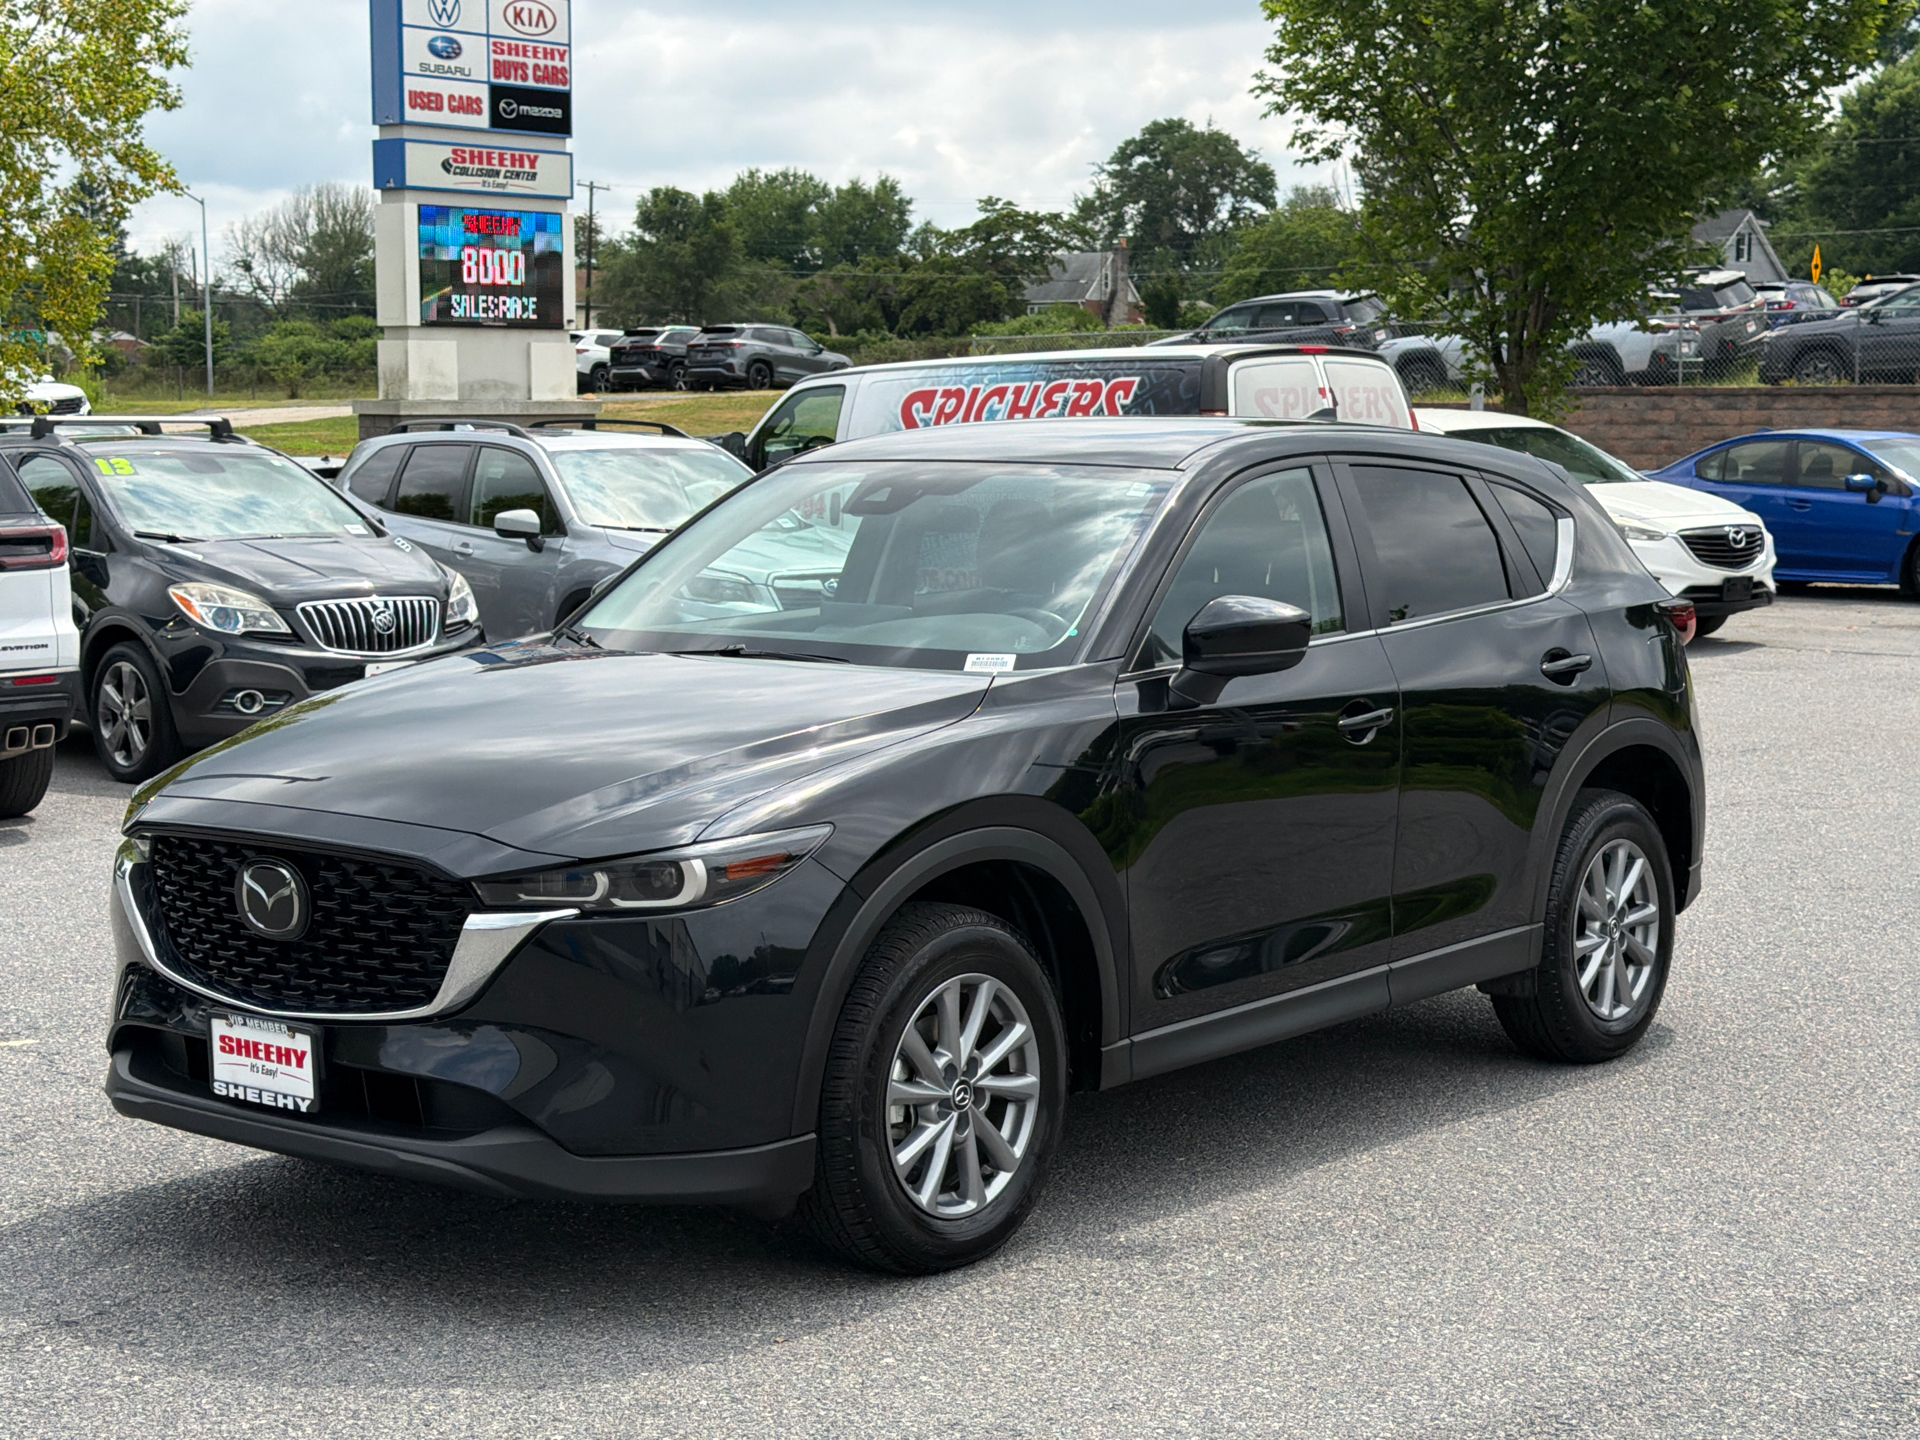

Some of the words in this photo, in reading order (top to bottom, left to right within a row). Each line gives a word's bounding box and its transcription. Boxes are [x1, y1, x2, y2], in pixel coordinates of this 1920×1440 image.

[513, 5, 548, 29] KIA
[491, 40, 567, 62] SHEEHY
[419, 62, 471, 77] SUBARU
[493, 59, 528, 82] BUYS
[532, 63, 568, 86] CARS
[408, 90, 443, 111] USED
[447, 94, 483, 116] CARS
[451, 148, 539, 169] SHEEHY
[452, 165, 501, 179] COLLISION
[503, 169, 537, 181] CENTER
[901, 378, 1140, 430] SPICHERS
[94, 457, 135, 476] 13
[228, 1014, 244, 1027] VIP
[246, 1017, 288, 1034] MEMBER
[218, 1034, 308, 1069] SHEEHY
[249, 1062, 260, 1073] It's
[261, 1065, 279, 1079] Easy!
[213, 1081, 312, 1112] SHEEHY
